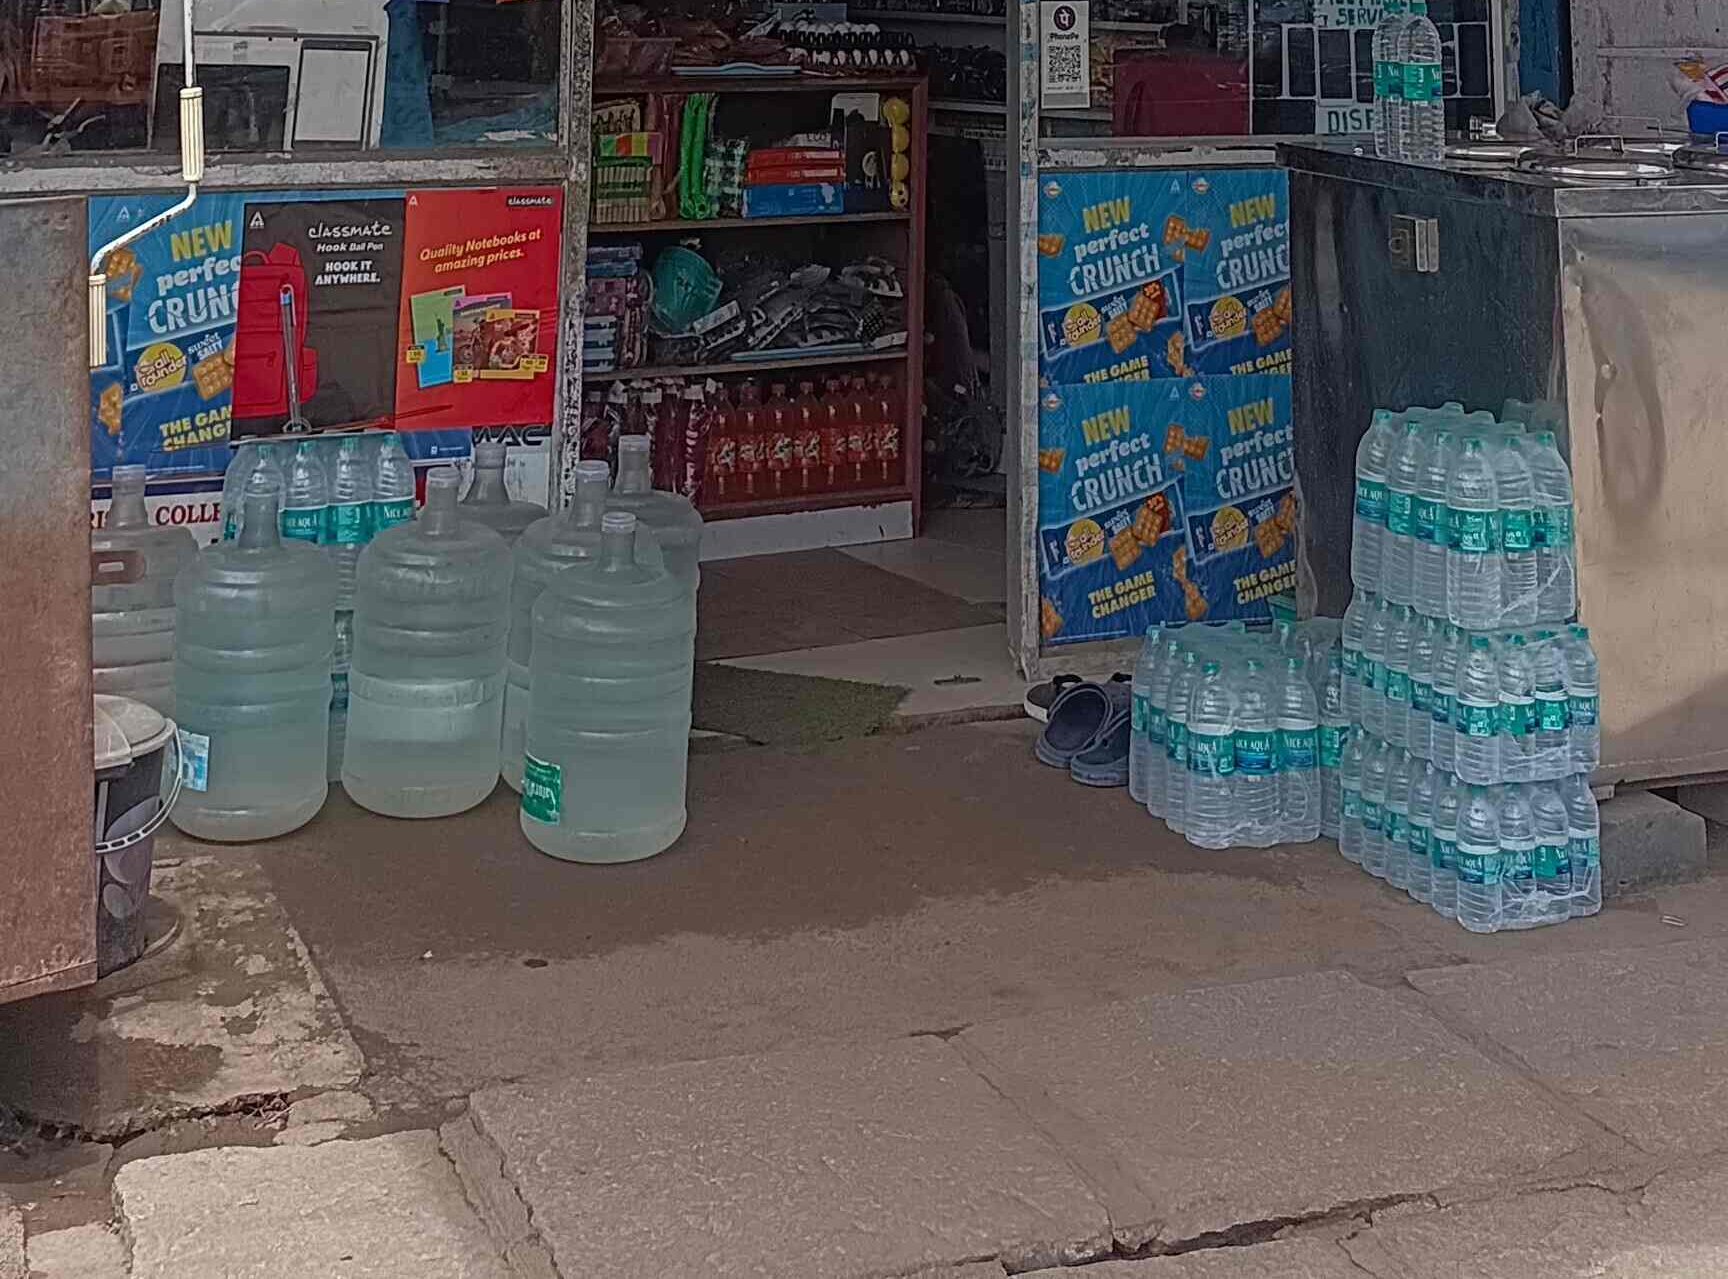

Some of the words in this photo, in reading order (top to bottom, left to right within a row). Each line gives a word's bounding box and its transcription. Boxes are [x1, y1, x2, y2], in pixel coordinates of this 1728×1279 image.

[1082, 195, 1131, 234] NEW
[1229, 193, 1275, 228] NEW
[171, 219, 232, 262] NEW
[308, 220, 393, 239] classmate
[316, 242, 347, 252] Hook
[419, 242, 464, 261] Quality
[465, 230, 527, 252] Notebooks
[528, 229, 541, 240] at
[1073, 222, 1150, 264] perfect
[156, 256, 242, 296] perfec
[315, 272, 380, 285] ANYWHERE.
[325, 261, 358, 272] HOOK
[360, 260, 372, 271] IT
[434, 255, 485, 274] amazing
[1067, 243, 1161, 296] CRUNCH
[1216, 243, 1289, 290] CRUNC
[1110, 355, 1150, 378] GAME
[160, 417, 192, 436] THE
[1081, 405, 1131, 446] NEW
[1227, 397, 1275, 436] NEW
[1075, 431, 1152, 477] perfect
[1069, 453, 1163, 512] CRUNCH
[1215, 446, 1296, 500] CRUNC
[1087, 588, 1113, 606] THE
[1114, 571, 1156, 595] GAME
[1233, 573, 1258, 591] THE
[1091, 585, 1156, 619] CHANGER
